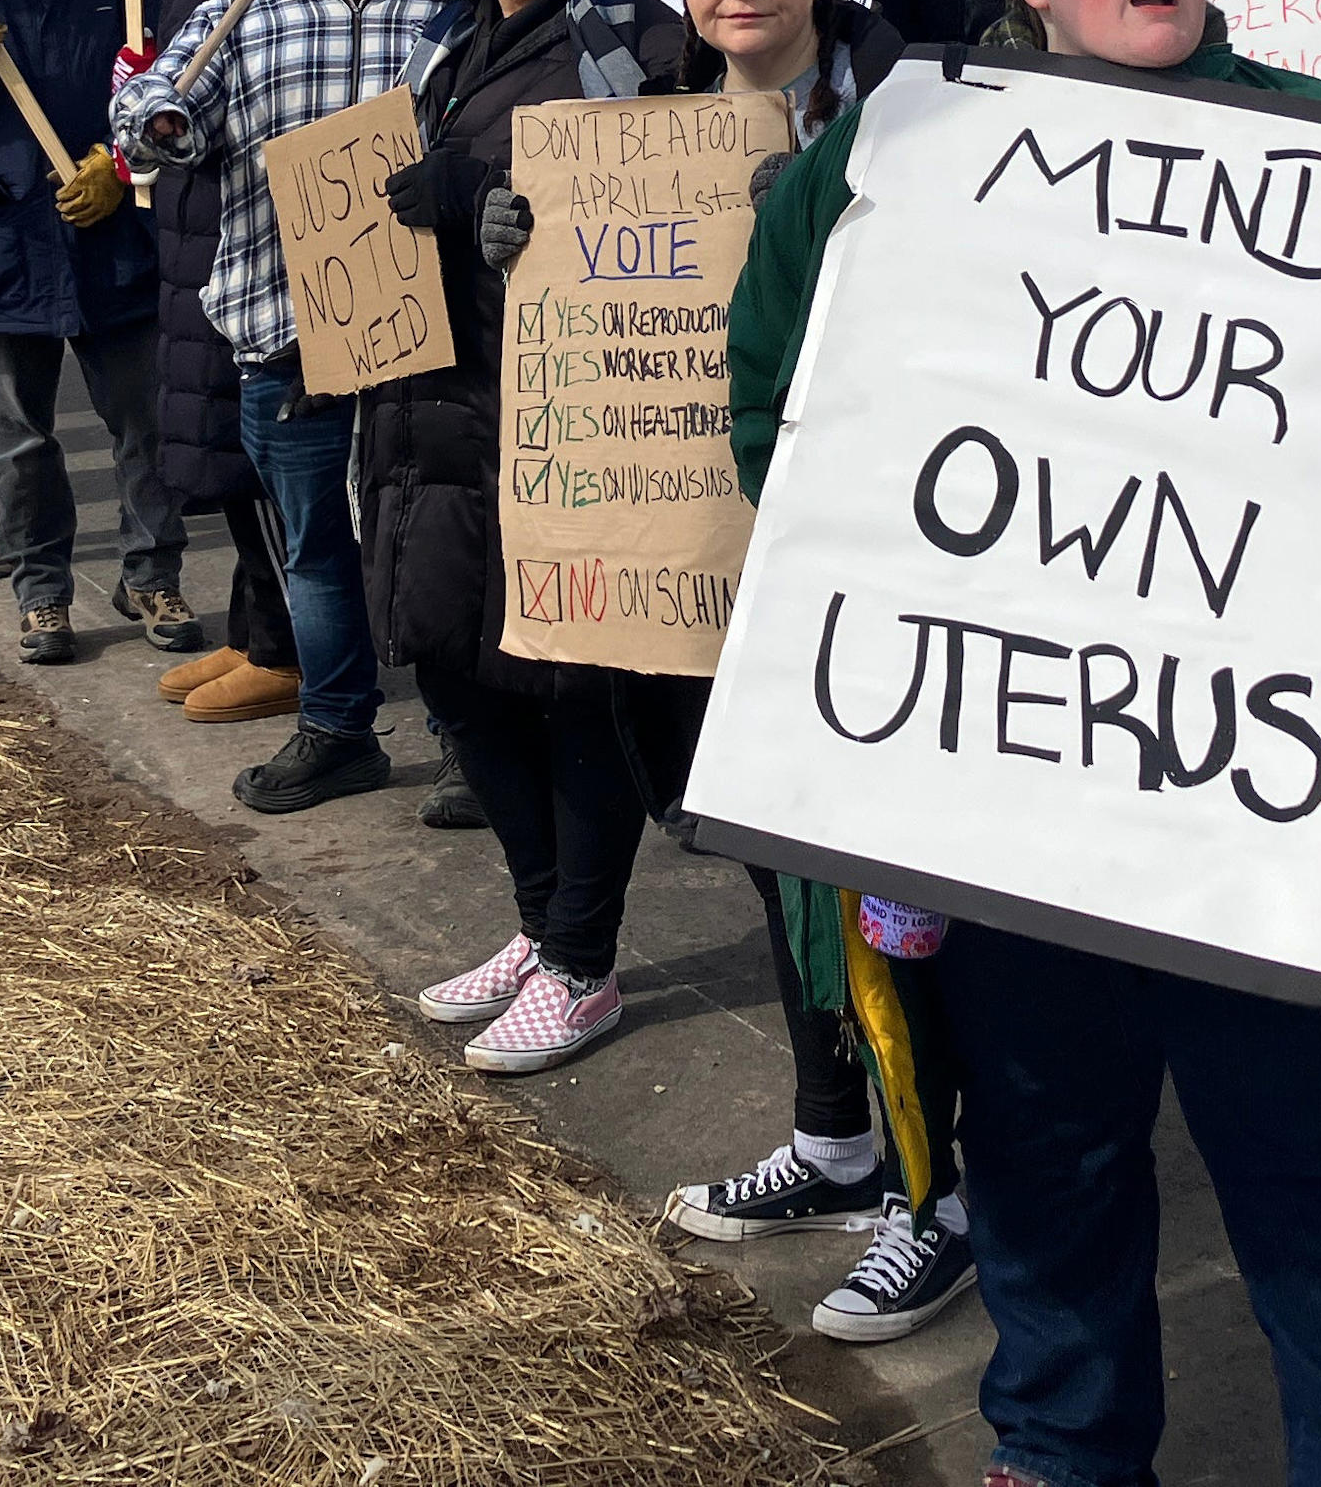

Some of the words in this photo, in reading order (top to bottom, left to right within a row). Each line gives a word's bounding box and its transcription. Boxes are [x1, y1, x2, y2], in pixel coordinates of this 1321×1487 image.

[520, 111, 602, 165] DON'T
[618, 110, 662, 165] BE
[668, 109, 690, 157] A
[694, 104, 767, 158] FOOL
[291, 137, 365, 241] JUST
[570, 172, 667, 222] APRIL
[301, 256, 354, 333] NO
[350, 211, 419, 294] TO
[575, 219, 699, 278] VOTE
[345, 294, 428, 377] WEID
[555, 297, 599, 338] YES
[602, 302, 625, 338] ON
[553, 351, 601, 388] YES
[603, 346, 683, 381] WORKER
[1020, 271, 1288, 444] YOUR
[552, 404, 600, 446] YES
[603, 404, 626, 440] ON
[556, 461, 601, 509] YES
[602, 465, 625, 503] ON
[913, 425, 1261, 619] OWN
[570, 558, 607, 623] NO
[618, 568, 649, 619] ON
